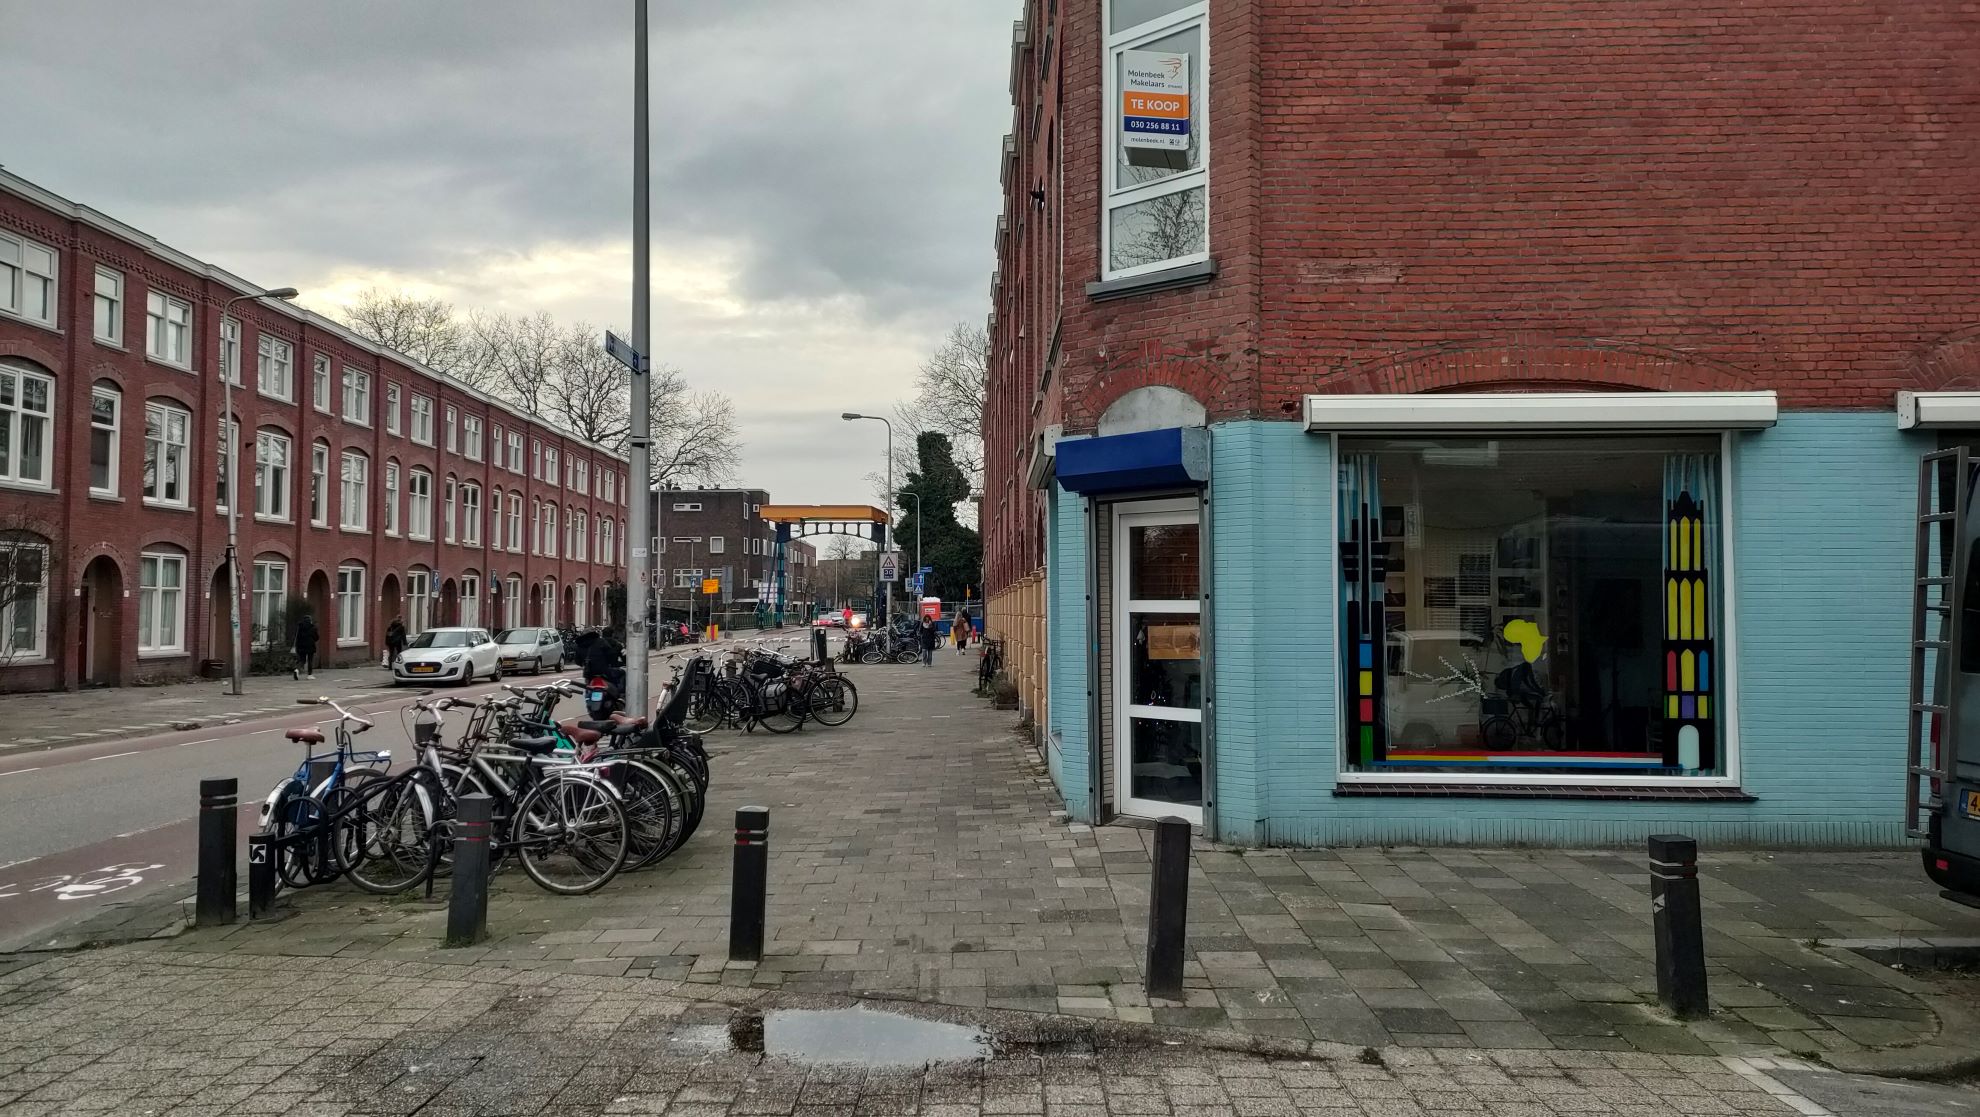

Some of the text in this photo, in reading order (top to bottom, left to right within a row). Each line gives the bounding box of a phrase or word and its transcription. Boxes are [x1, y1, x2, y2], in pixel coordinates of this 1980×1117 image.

[1127, 69, 1165, 79] Molenbeek
[1130, 79, 1165, 88] Makelaars
[1130, 98, 1180, 112] TE KOOP
[1130, 120, 1180, 131] 030 256 88 11
